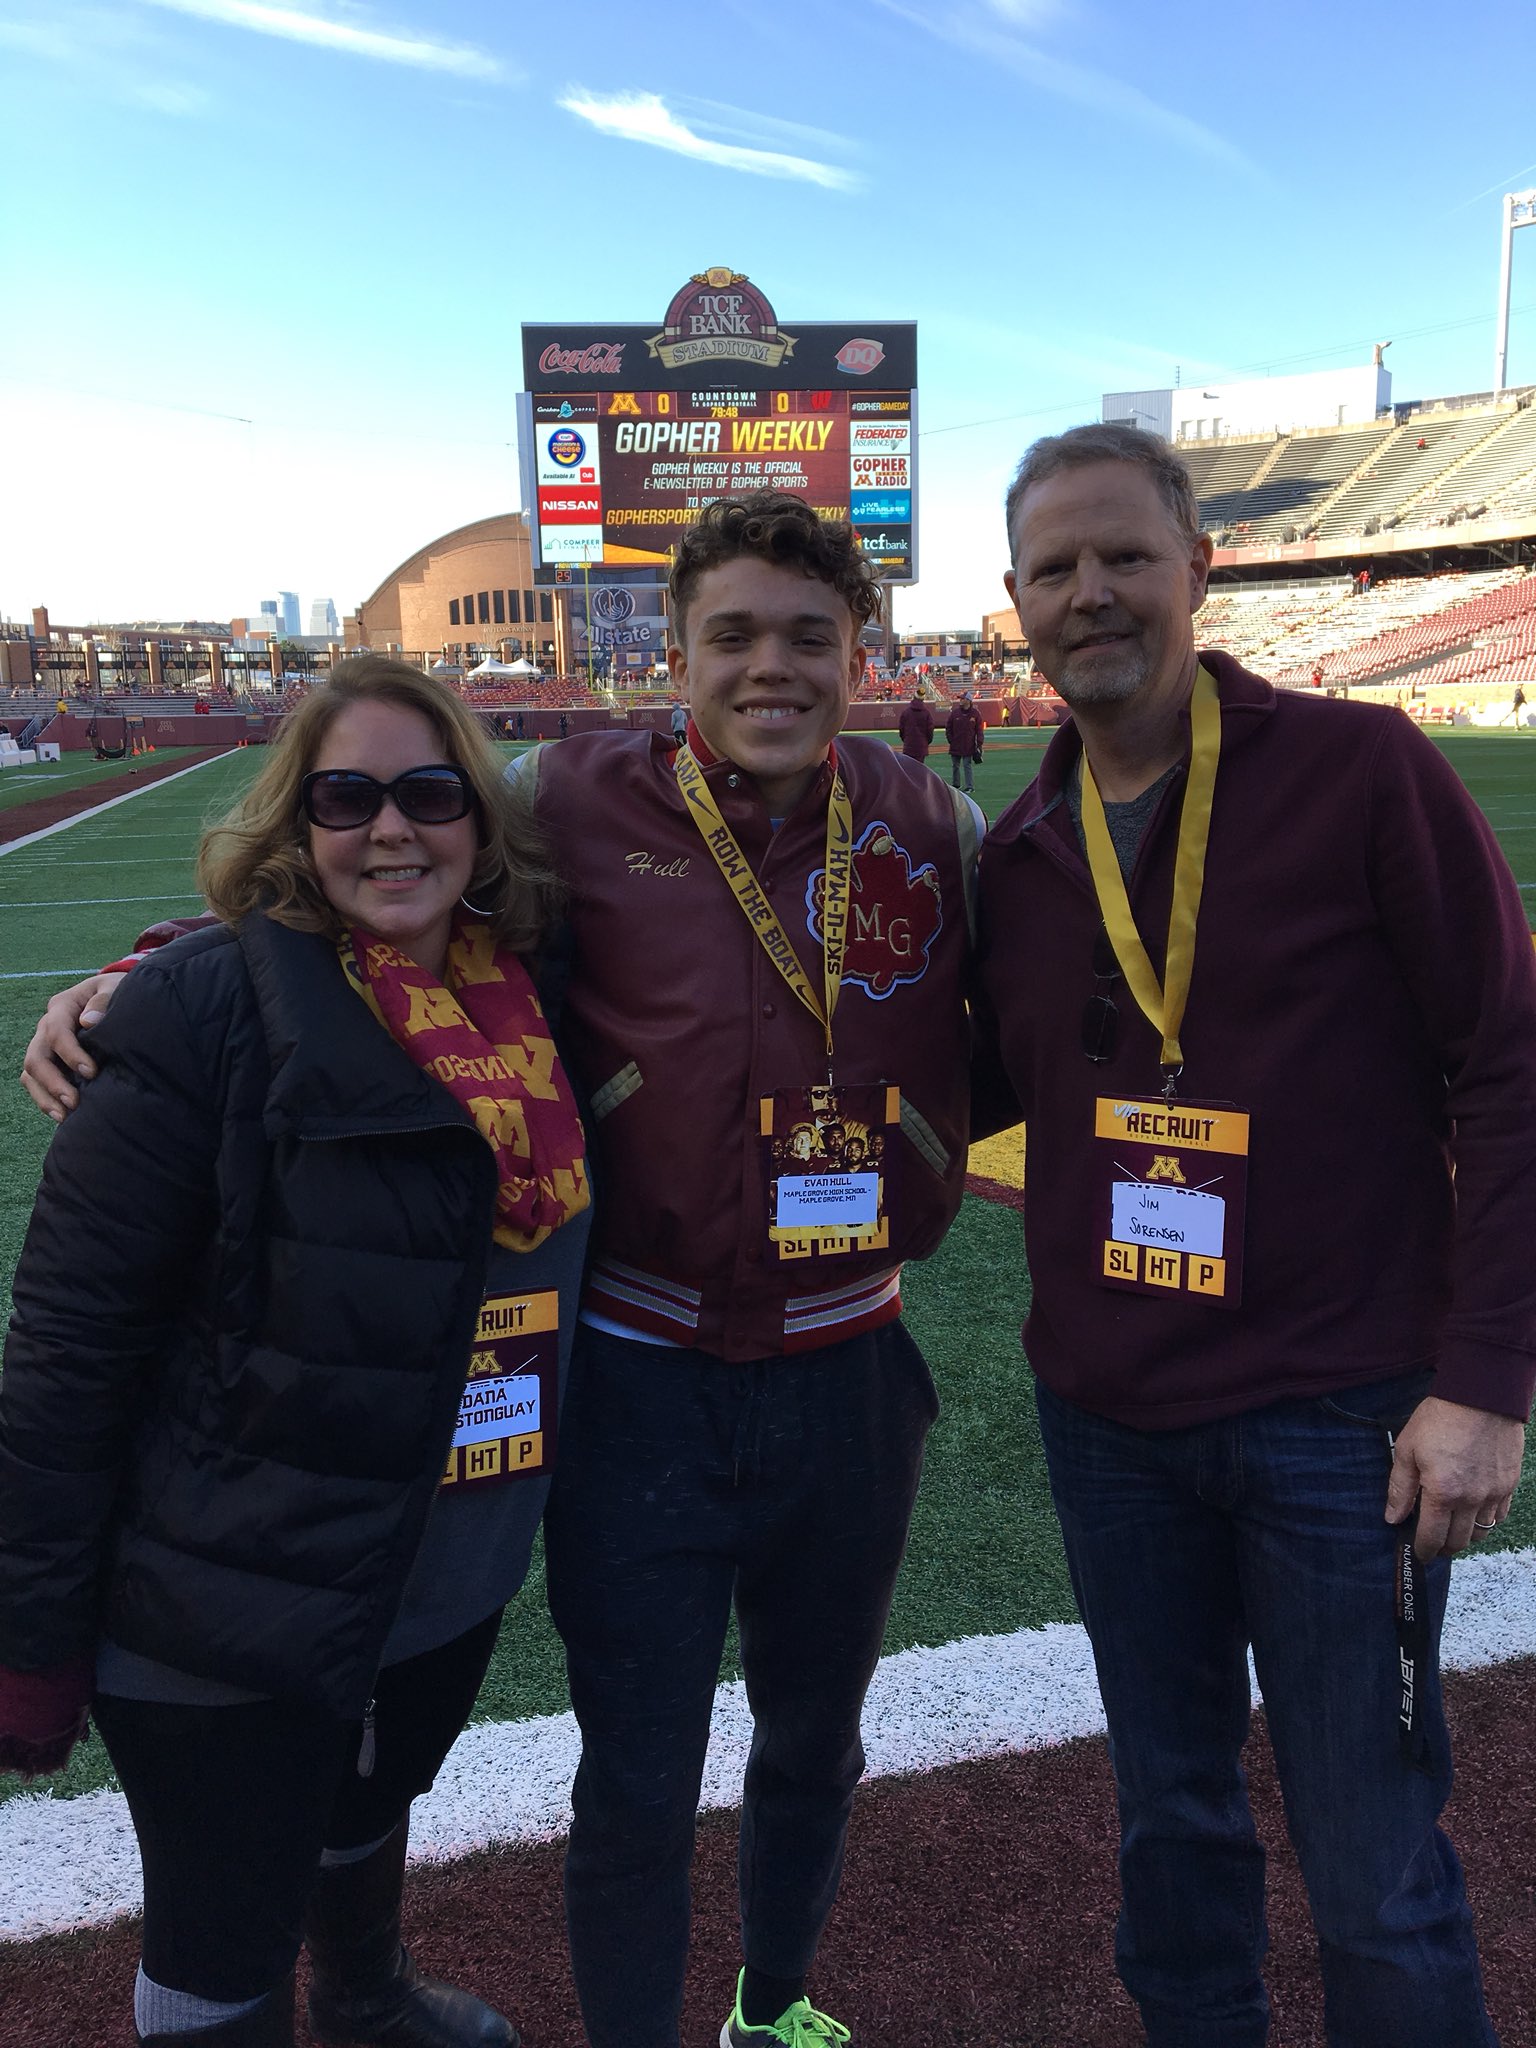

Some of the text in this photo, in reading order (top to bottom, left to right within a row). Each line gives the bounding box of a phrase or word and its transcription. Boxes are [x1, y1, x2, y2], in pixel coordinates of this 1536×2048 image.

[698, 295, 742, 315] TCF
[690, 314, 752, 335] BANK
[539, 342, 626, 374] Coca-Cola
[672, 339, 769, 362] STADIUM
[844, 348, 877, 366] DQ
[608, 393, 641, 415] M
[657, 393, 670, 414] 0
[691, 391, 757, 401] COUNTDOWN
[777, 392, 789, 413] 0
[711, 407, 738, 418] 79:48
[615, 420, 834, 454] GOPHER WEEKLY
[852, 439, 890, 447] INSURANCE
[855, 429, 908, 439] FEDERATED
[652, 461, 803, 475] GOPHER WEEKLY IS THE OFFICIAL
[853, 458, 907, 472] GOPHER
[644, 475, 808, 490] E-NEWSLETTER OF GOPHER SPORTS
[854, 474, 873, 486] M
[875, 476, 907, 486] RADIO
[542, 500, 599, 511] NISSAN
[687, 496, 698, 508] TO
[557, 571, 570, 582] 25
[580, 625, 651, 645] Allstate
[624, 851, 690, 877] Hull
[708, 825, 801, 978] ROW THE BOAT
[827, 848, 850, 976] SKI-U-MAH
[1114, 1103, 1140, 1119] VIP
[1126, 1112, 1214, 1142] RECRUIT
[1146, 1154, 1186, 1184] M
[783, 1190, 807, 1198] MAPLE
[807, 1189, 829, 1197] GROVE
[829, 1188, 844, 1196] HIGH
[844, 1187, 867, 1195] SCHOOL
[804, 1177, 852, 1188] EVAN HULL
[799, 1196, 822, 1204] MAPLE
[1139, 1194, 1159, 1212] JIM
[1109, 1248, 1133, 1274] SL
[1151, 1256, 1177, 1281] HT
[1200, 1264, 1214, 1287] P
[481, 1304, 527, 1332] RUIT
[467, 1350, 502, 1378] M
[462, 1387, 508, 1410] DANA
[456, 1399, 536, 1429] STONGUAY
[471, 1447, 497, 1473] HT
[519, 1440, 533, 1464] P
[1403, 1543, 1415, 1622] NUMBER ONES
